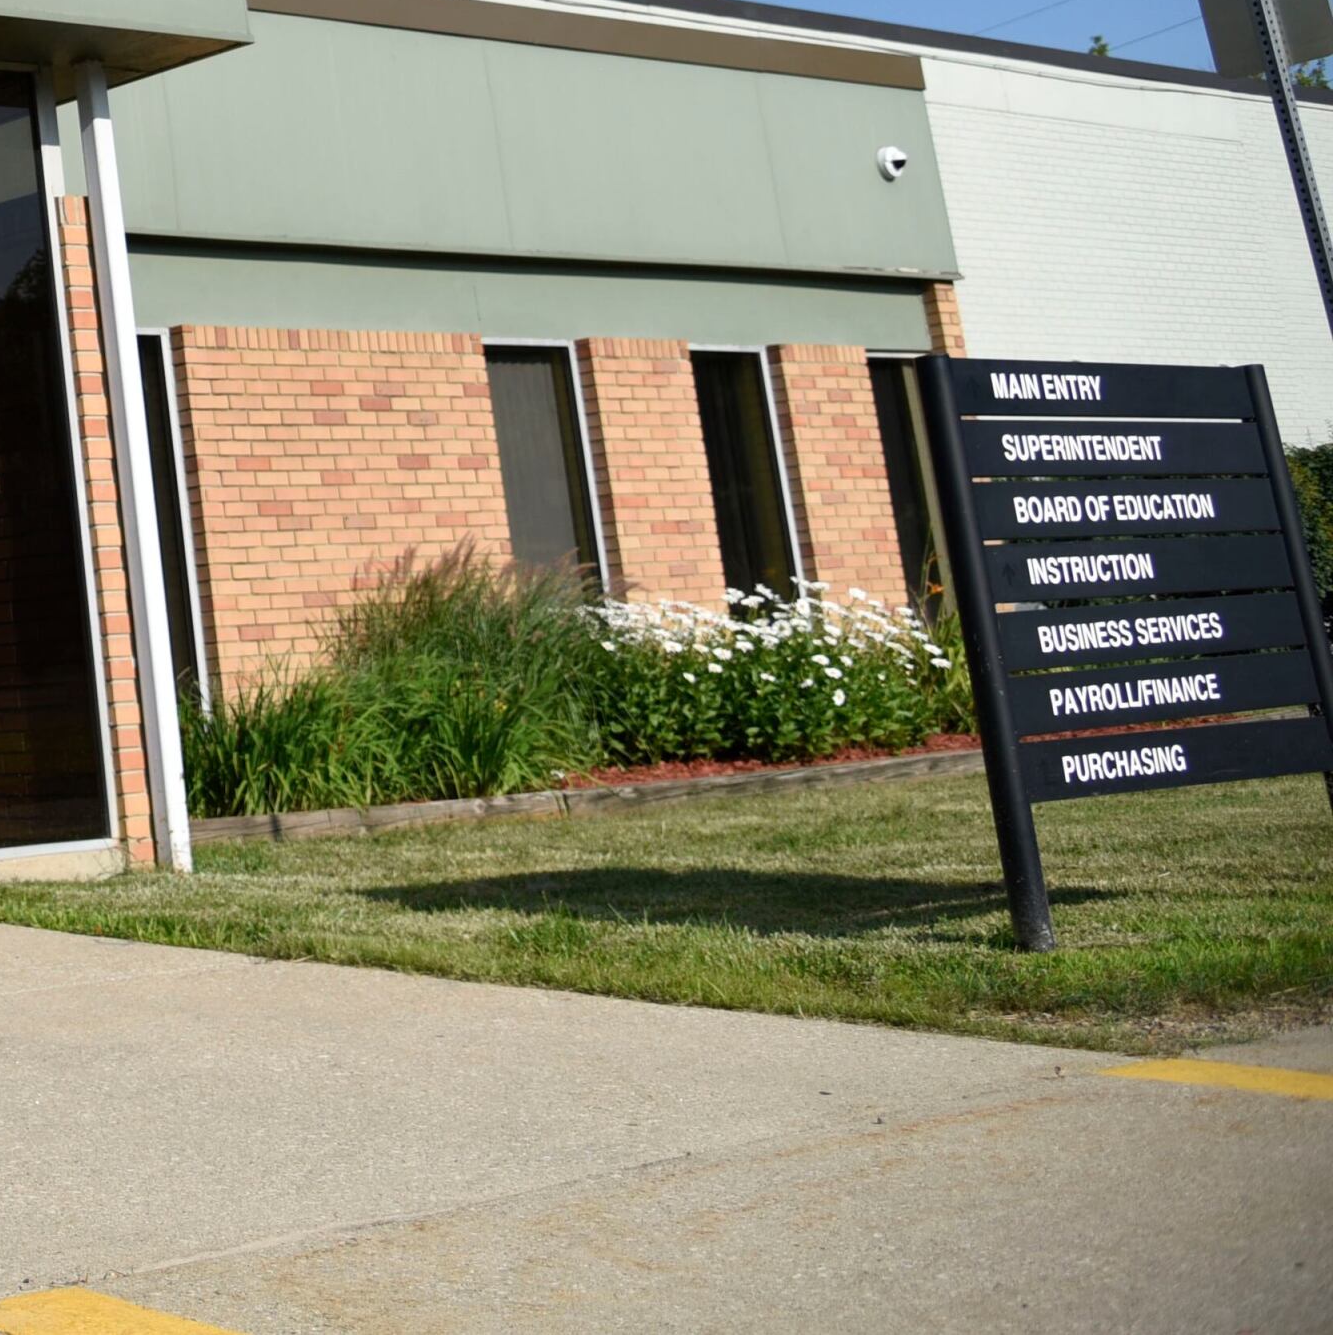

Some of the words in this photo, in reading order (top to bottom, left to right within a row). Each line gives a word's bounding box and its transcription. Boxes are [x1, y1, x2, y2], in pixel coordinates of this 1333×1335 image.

[991, 373, 1040, 400] MAIN
[1042, 374, 1102, 400] ENTRY
[1001, 434, 1162, 461] SUPERINTENDENT
[1013, 496, 1082, 524] BOARD
[1085, 495, 1111, 522] OF
[1115, 493, 1215, 521] EDUCATION
[1026, 553, 1155, 586] INSTRUCTION
[1037, 618, 1133, 654] BUSINESS
[1134, 612, 1224, 645] SERVICES
[1049, 673, 1222, 716] PAYROLL/FINANCE
[1062, 744, 1187, 783] PURCHASING
